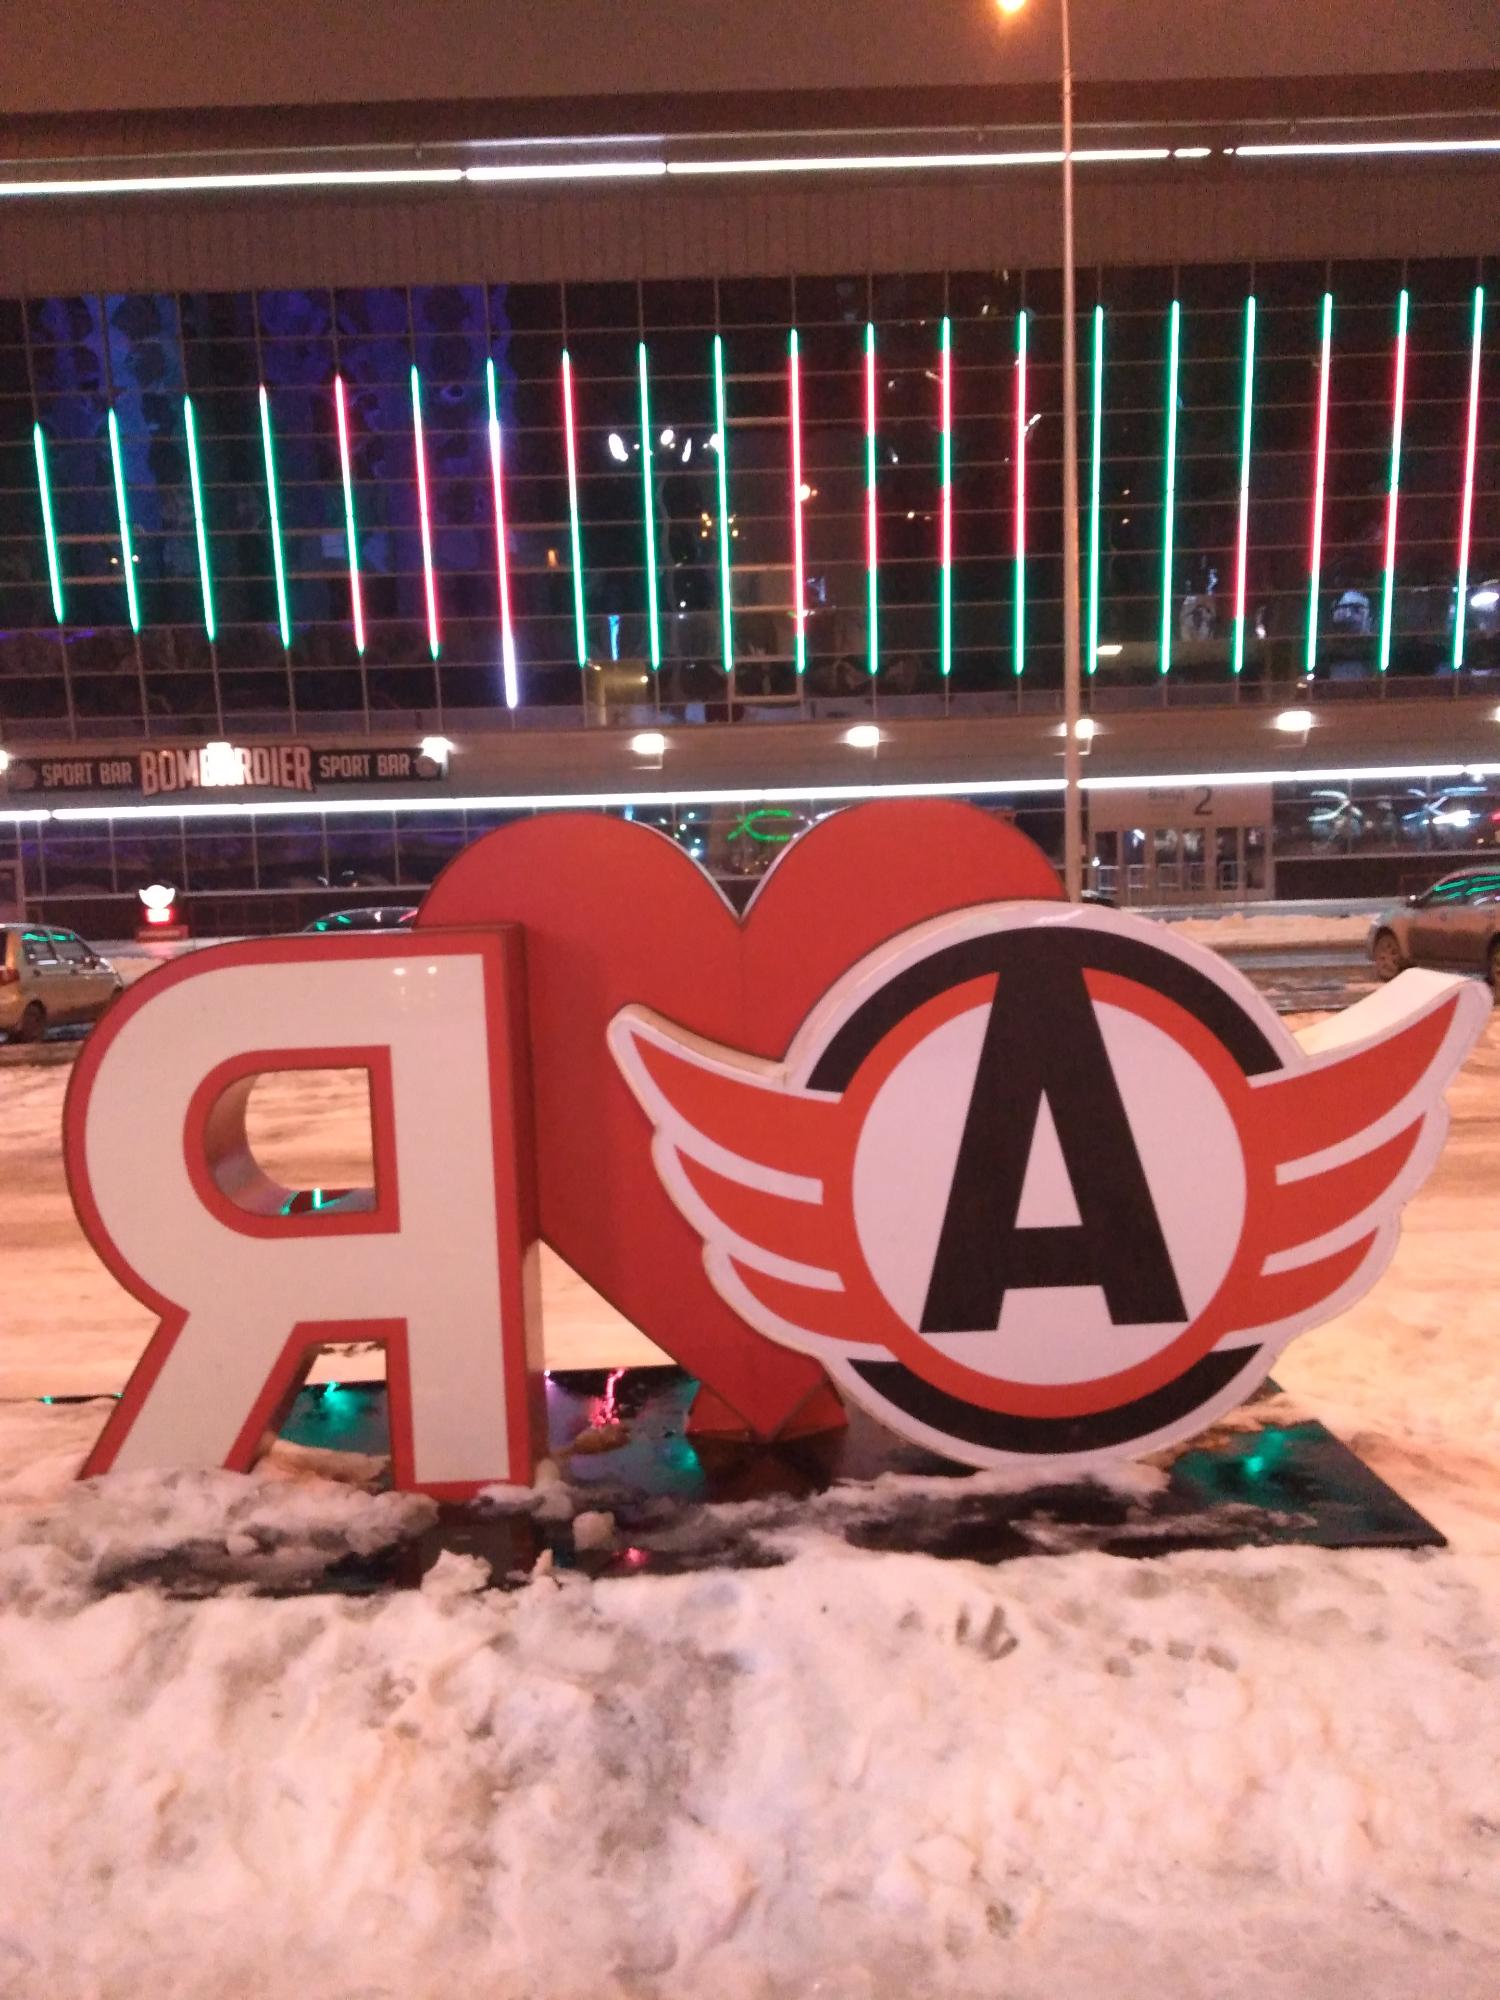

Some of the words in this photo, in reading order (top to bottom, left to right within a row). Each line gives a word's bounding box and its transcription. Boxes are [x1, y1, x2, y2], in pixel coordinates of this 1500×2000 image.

[41, 762, 93, 787] SPORT
[100, 761, 134, 785] BAR
[140, 746, 313, 796] BOMRDIER
[319, 754, 370, 778] SPORT
[377, 753, 410, 776] BAR
[1193, 785, 1213, 816] 2
